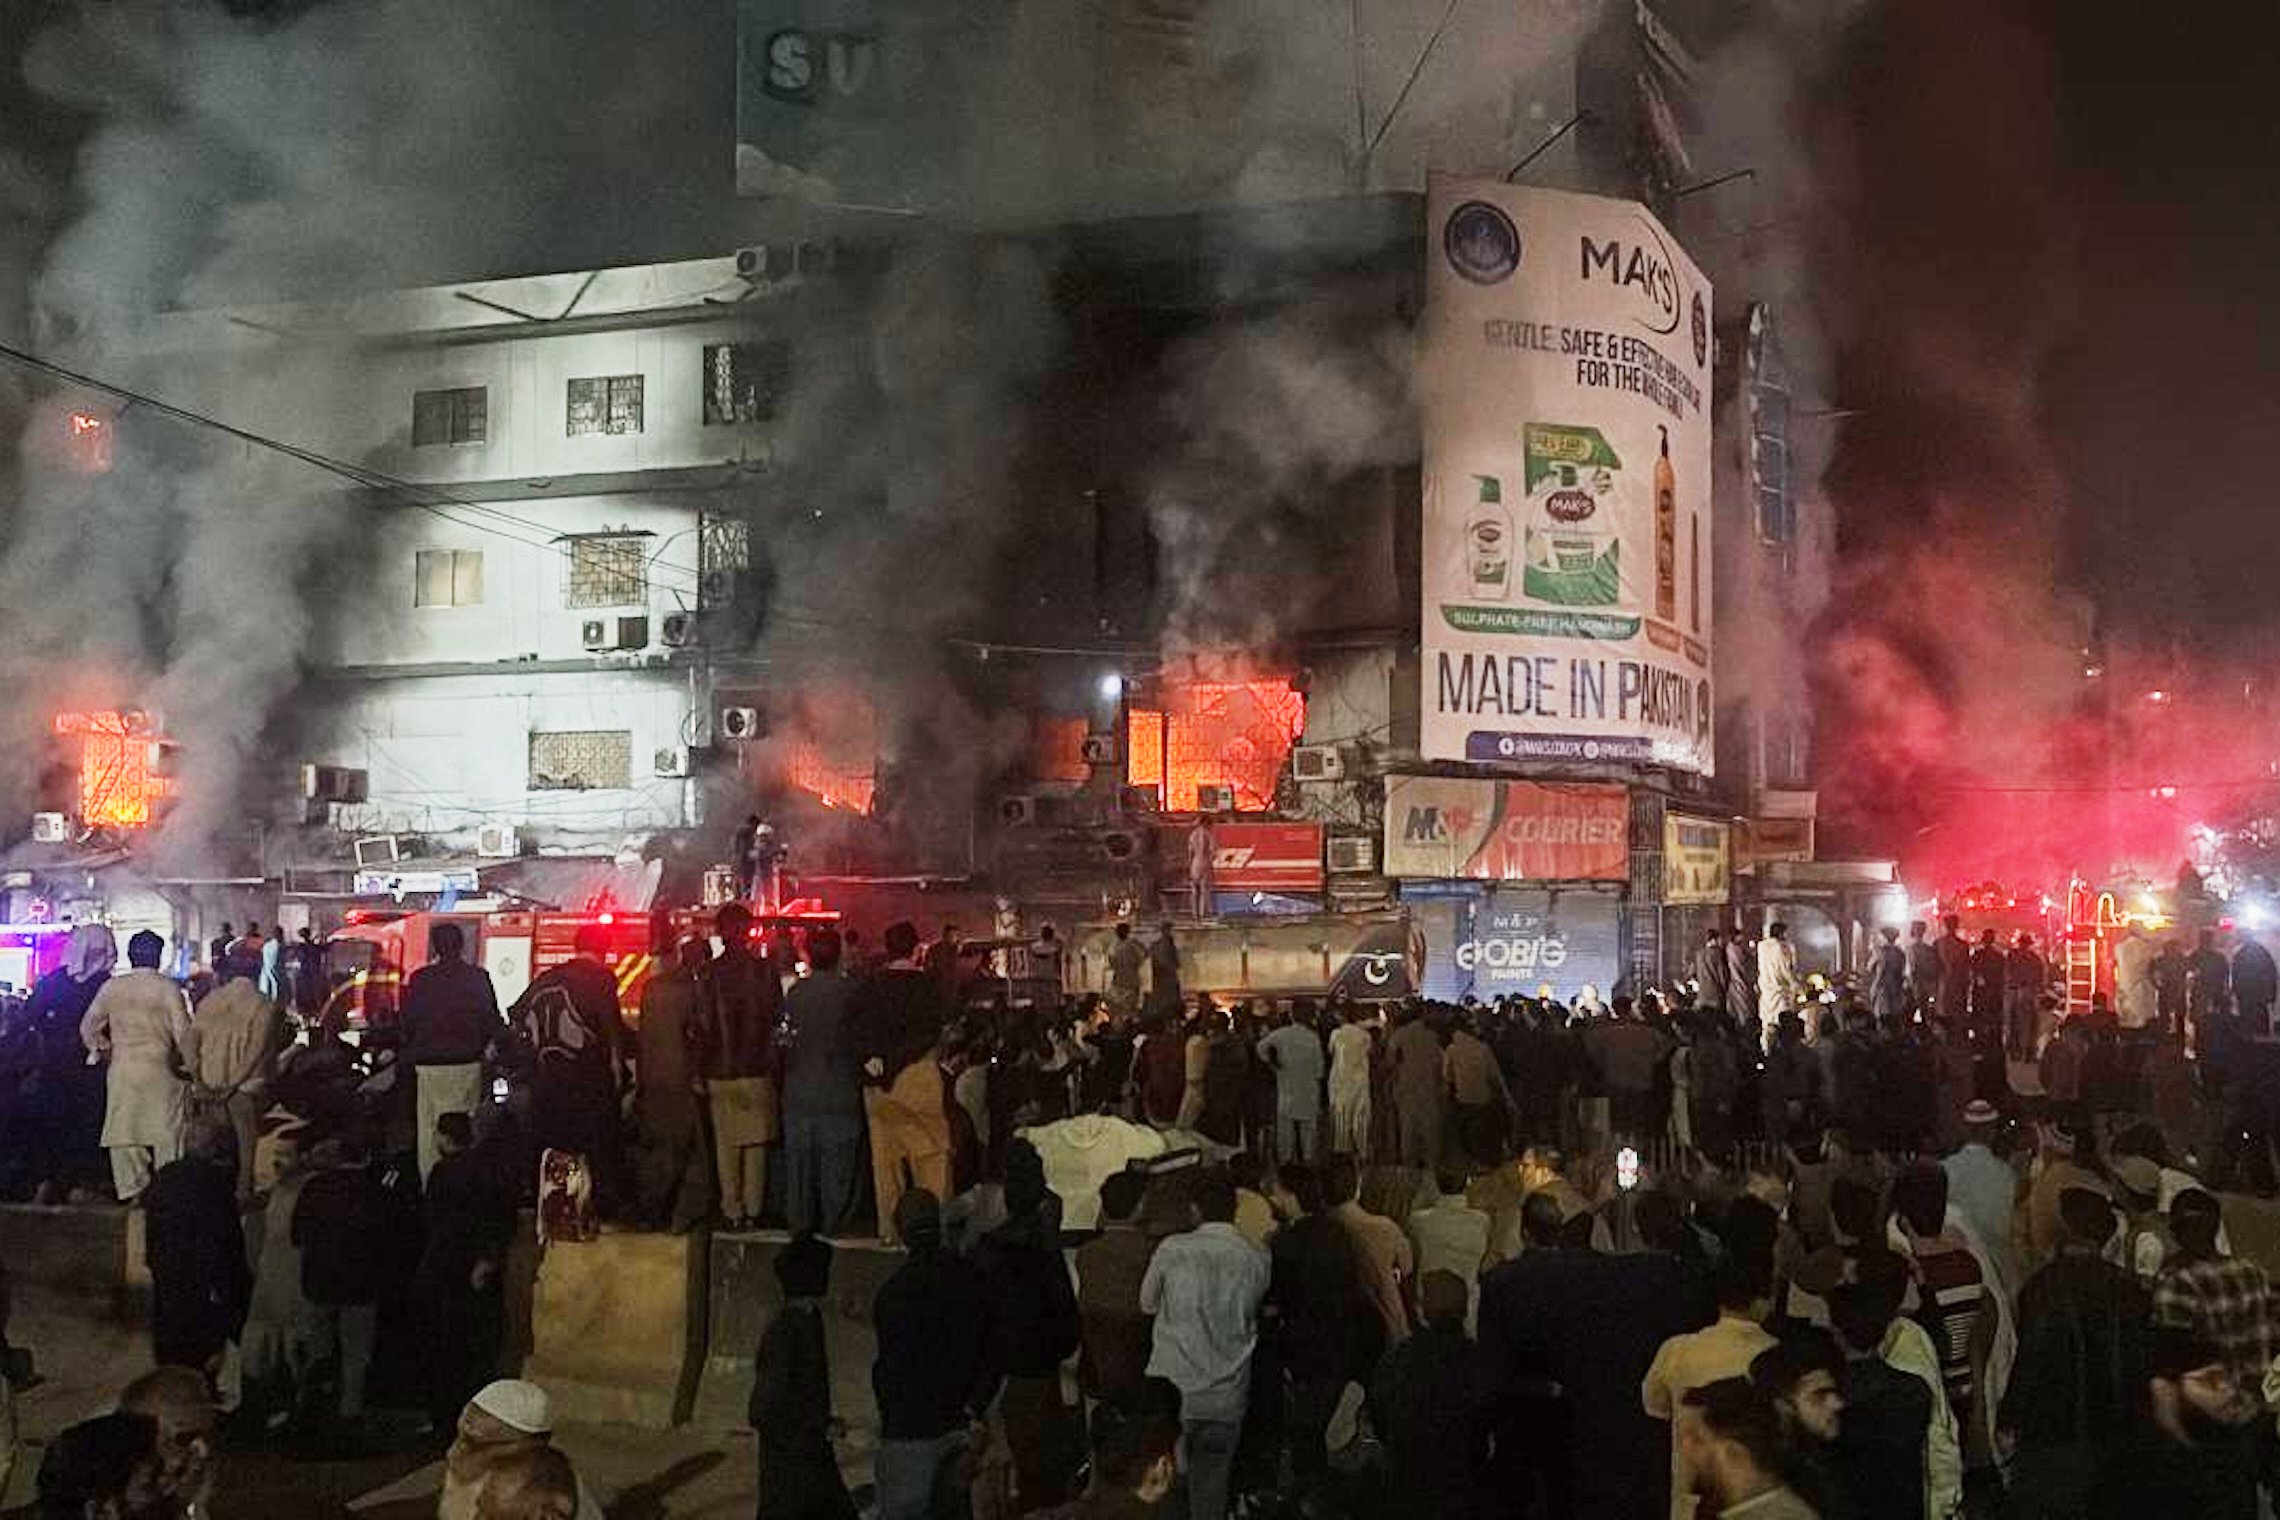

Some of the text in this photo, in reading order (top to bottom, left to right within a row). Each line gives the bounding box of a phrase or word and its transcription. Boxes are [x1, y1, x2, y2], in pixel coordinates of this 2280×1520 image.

[1581, 236, 1674, 314] MAK'S
[1561, 328, 1605, 358] SAFE
[1607, 334, 1618, 360] &
[1576, 358, 1610, 387] FOR
[1613, 363, 1642, 393] THE
[1437, 651, 1693, 731] MADE IN PAKISTAN
[1506, 815, 1623, 845] COURIER
